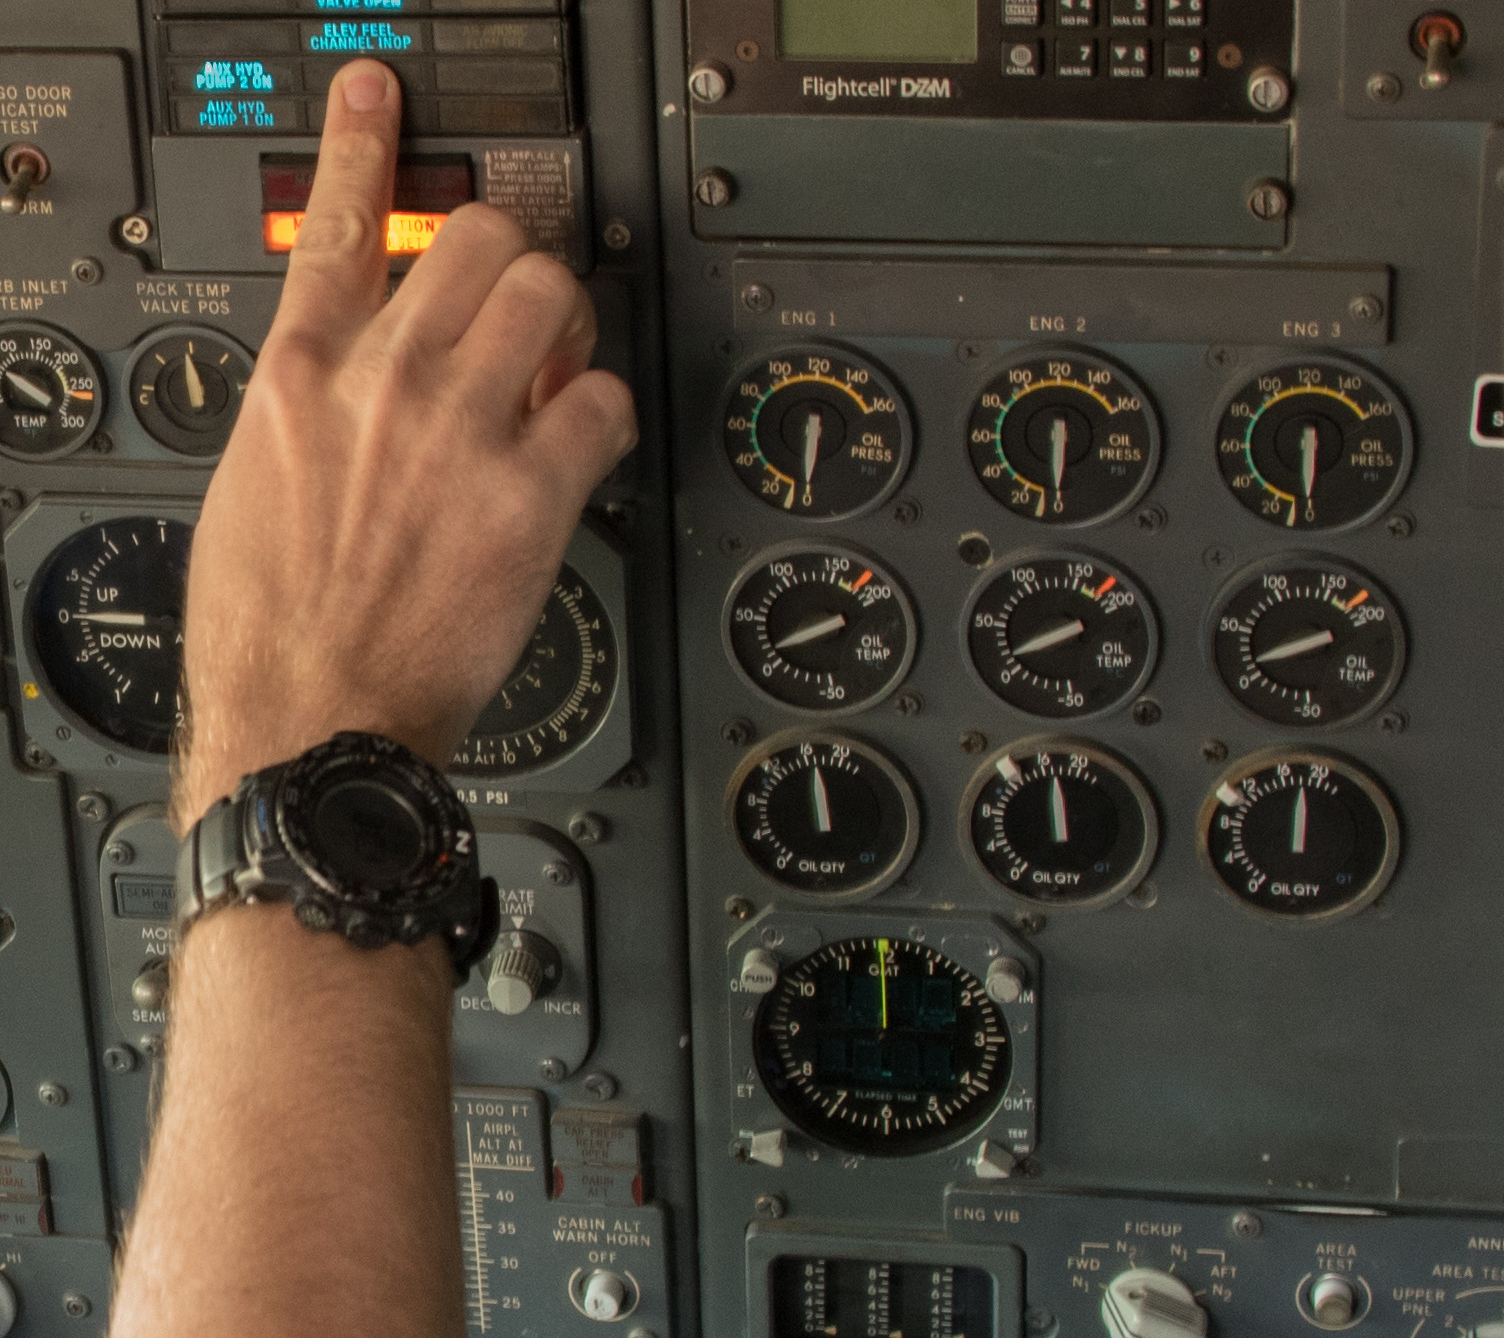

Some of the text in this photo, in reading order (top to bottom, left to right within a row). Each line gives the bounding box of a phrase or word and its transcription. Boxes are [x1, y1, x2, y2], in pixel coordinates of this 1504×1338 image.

[324, 23, 392, 37] ELEV FEEL
[310, 35, 411, 49] CHANNEL INOP
[25, 84, 72, 100] DOOR
[802, 76, 892, 98] Flightcell
[206, 101, 265, 115] AUX HYD
[1, 119, 41, 135] TEST
[199, 113, 274, 126] PUMP 1 ON
[22, 277, 70, 294] INLET
[135, 280, 231, 298] PACK TEMP
[0, 295, 45, 311] TEMP
[140, 298, 231, 314] VALVE POS
[781, 311, 835, 327] ENG 1
[861, 433, 882, 448] OIL
[851, 446, 892, 461] PRESS
[96, 588, 118, 603] UP
[100, 634, 160, 649] DOWN
[953, 1207, 1020, 1224] ENG VIB
[558, 1217, 641, 1232] CABIN ALT
[552, 1229, 650, 1246] WARN HORN
[1392, 1288, 1445, 1304] UPPER
